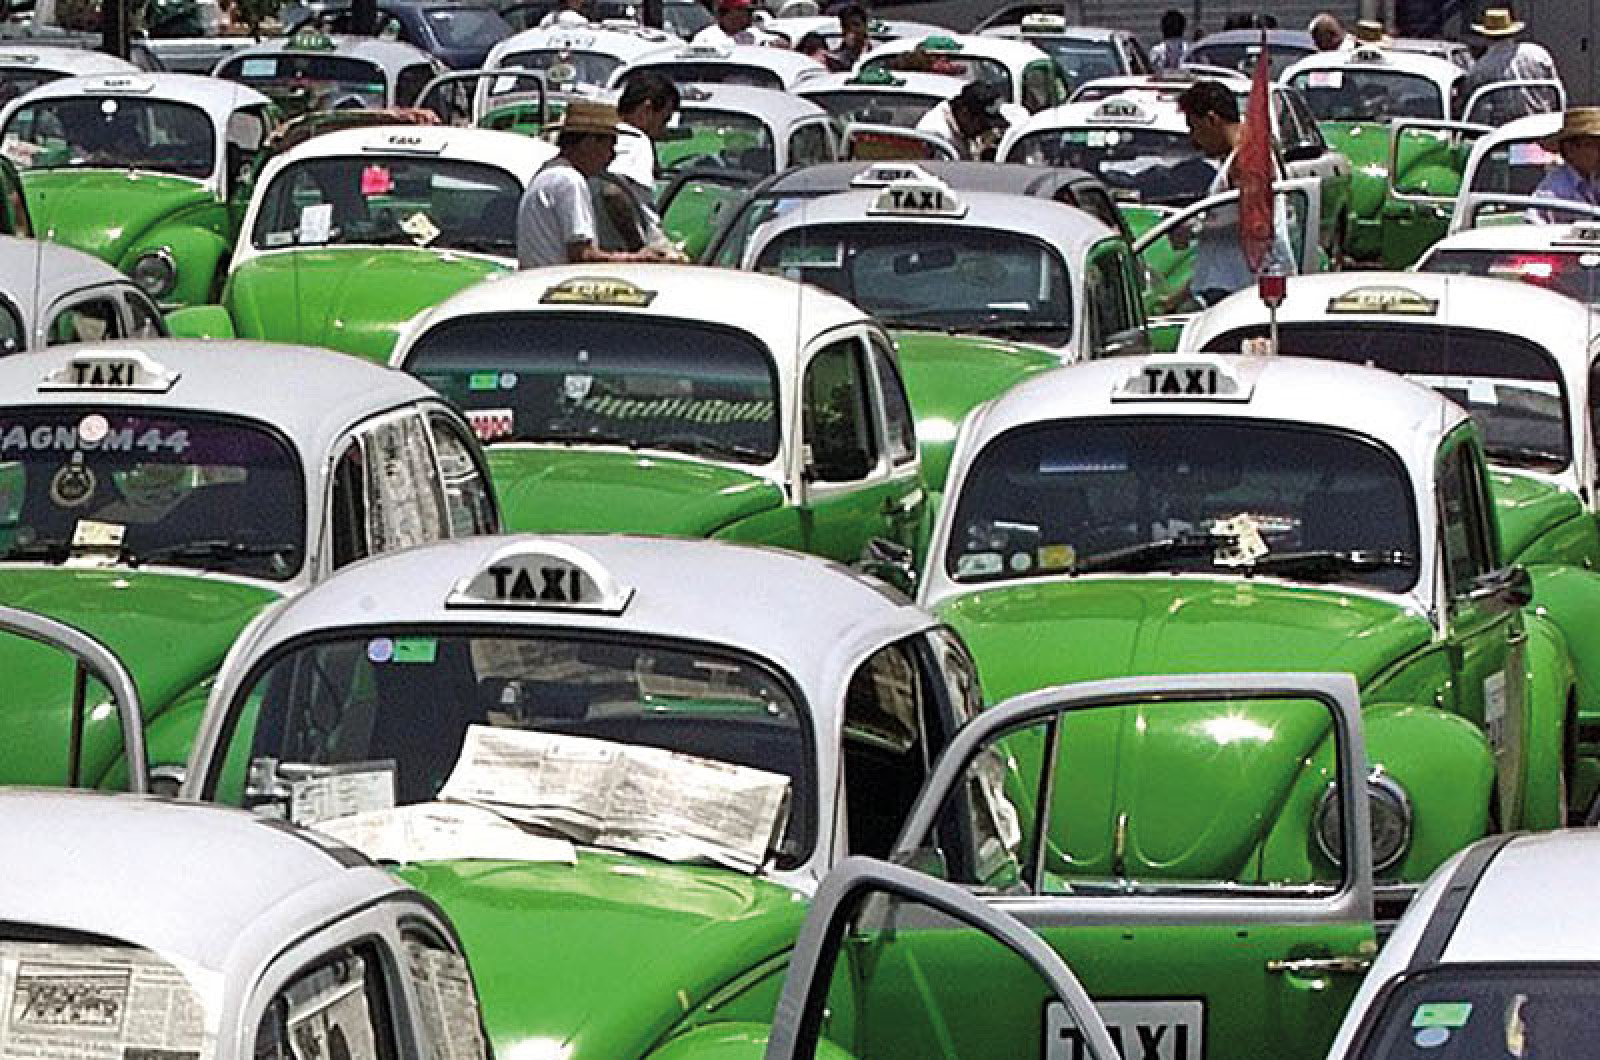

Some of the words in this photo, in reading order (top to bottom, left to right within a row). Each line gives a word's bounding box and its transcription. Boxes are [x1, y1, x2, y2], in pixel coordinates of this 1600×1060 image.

[890, 190, 943, 209] TAXI
[71, 362, 135, 386] TAXI
[1144, 368, 1218, 394] TAXI
[137, 429, 190, 454] 44
[488, 565, 582, 602] TAXI
